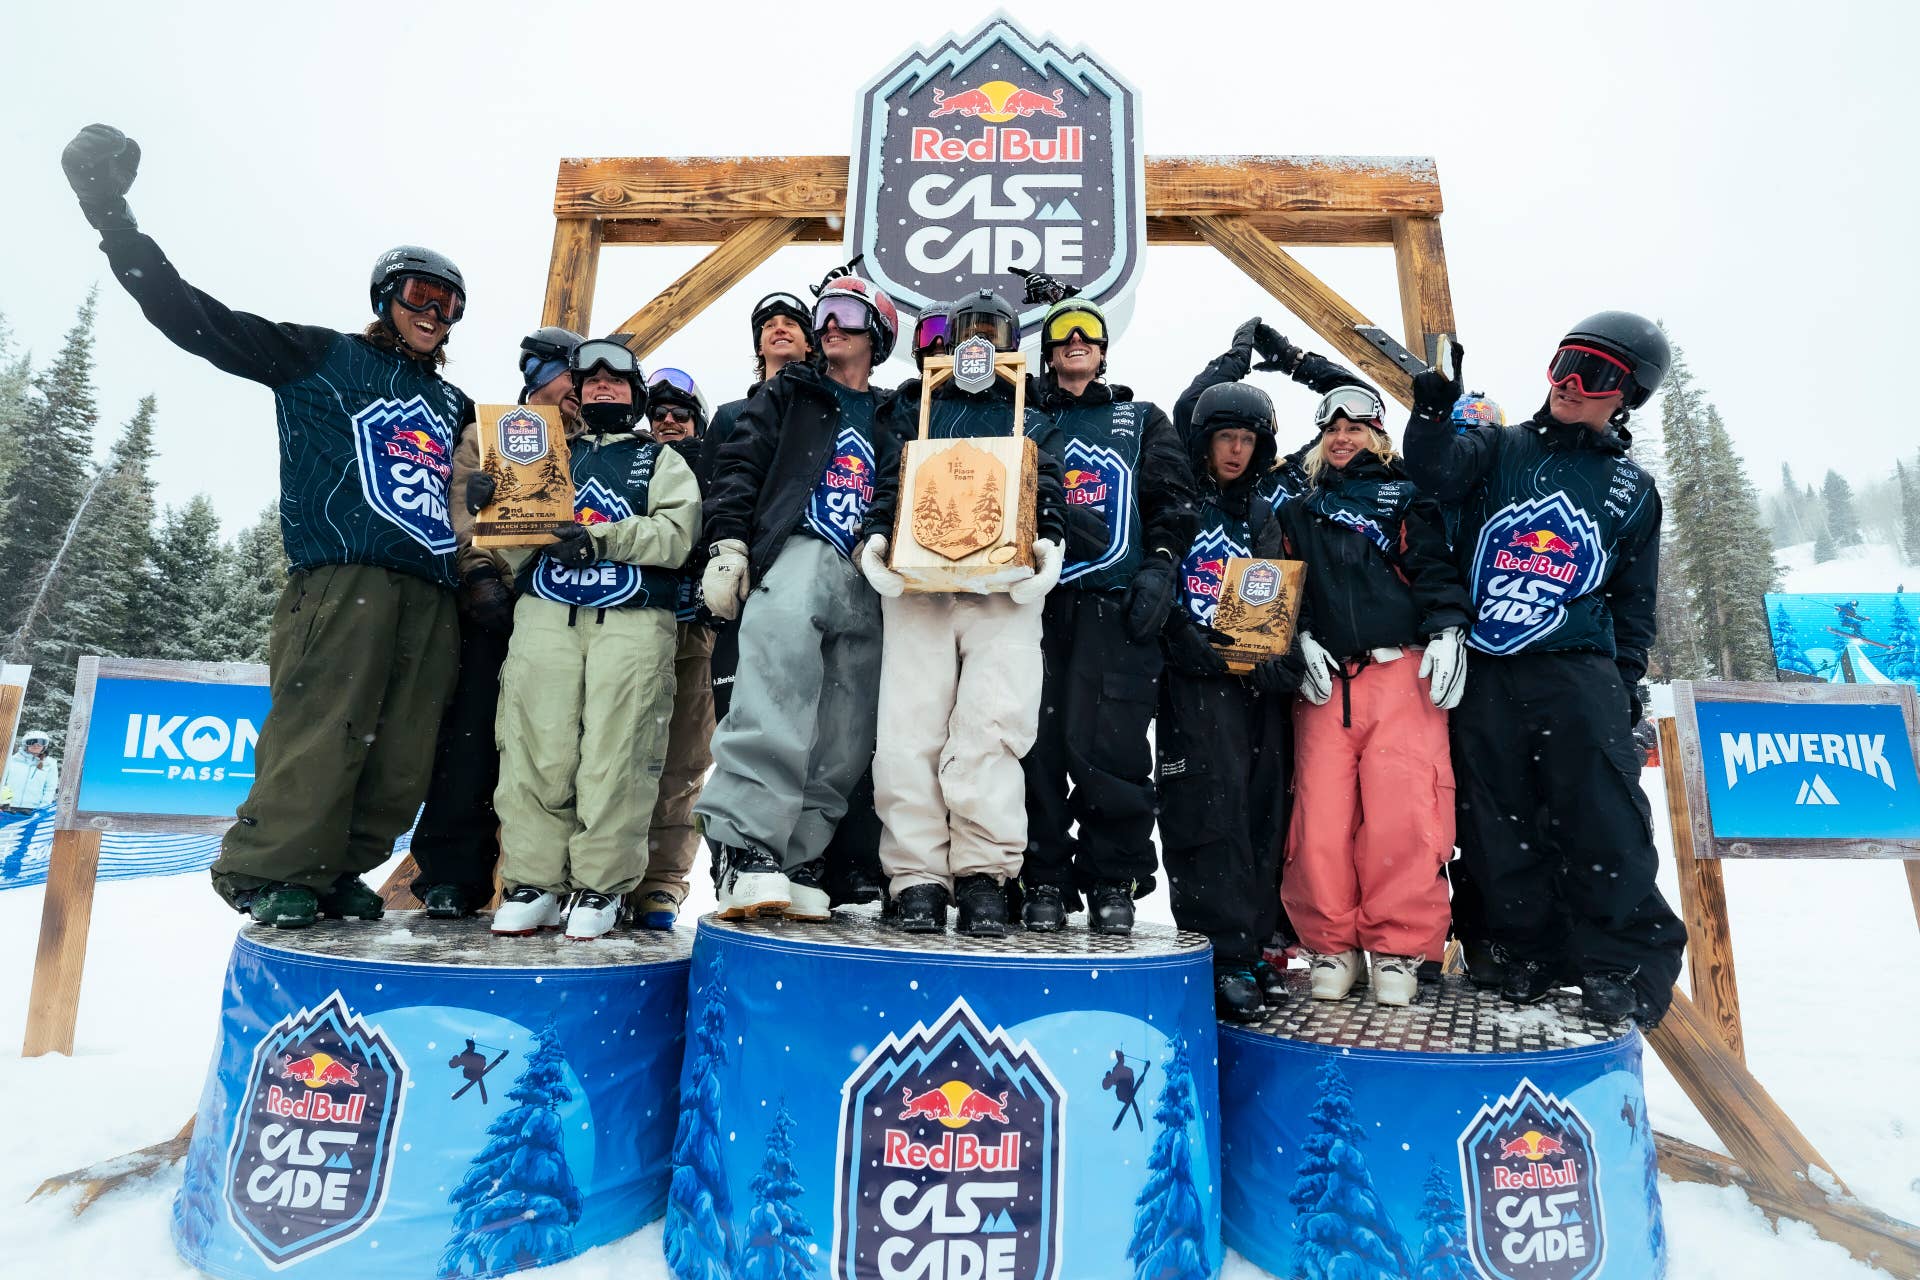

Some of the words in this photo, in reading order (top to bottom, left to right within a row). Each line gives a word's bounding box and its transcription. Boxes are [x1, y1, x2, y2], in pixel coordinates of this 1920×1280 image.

[910, 126, 997, 162] Red
[999, 126, 1083, 162] Bull
[908, 174, 1083, 220] CAS
[904, 226, 1084, 275] CADE
[508, 443, 539, 453] CADE
[826, 470, 855, 489] Red
[1074, 483, 1107, 504] Bull
[1609, 486, 1632, 503] IKON
[1494, 550, 1535, 572] Red
[1534, 554, 1578, 584] Bull
[1187, 575, 1222, 600] Red
[167, 766, 225, 781] PASS
[1720, 732, 1897, 791] MAVERIK
[266, 1085, 312, 1121] Red
[310, 1092, 367, 1124] Bull
[259, 1123, 359, 1167] CAS
[883, 1128, 953, 1172] Red
[954, 1131, 1021, 1172] Bull
[246, 1164, 351, 1211] CADE
[1493, 1162, 1540, 1190] Red
[1537, 1159, 1579, 1189] Bull
[880, 1179, 1018, 1234] CAS
[1496, 1191, 1579, 1229] CAS
[877, 1236, 1017, 1280] CADE
[1501, 1225, 1586, 1264] CADE
